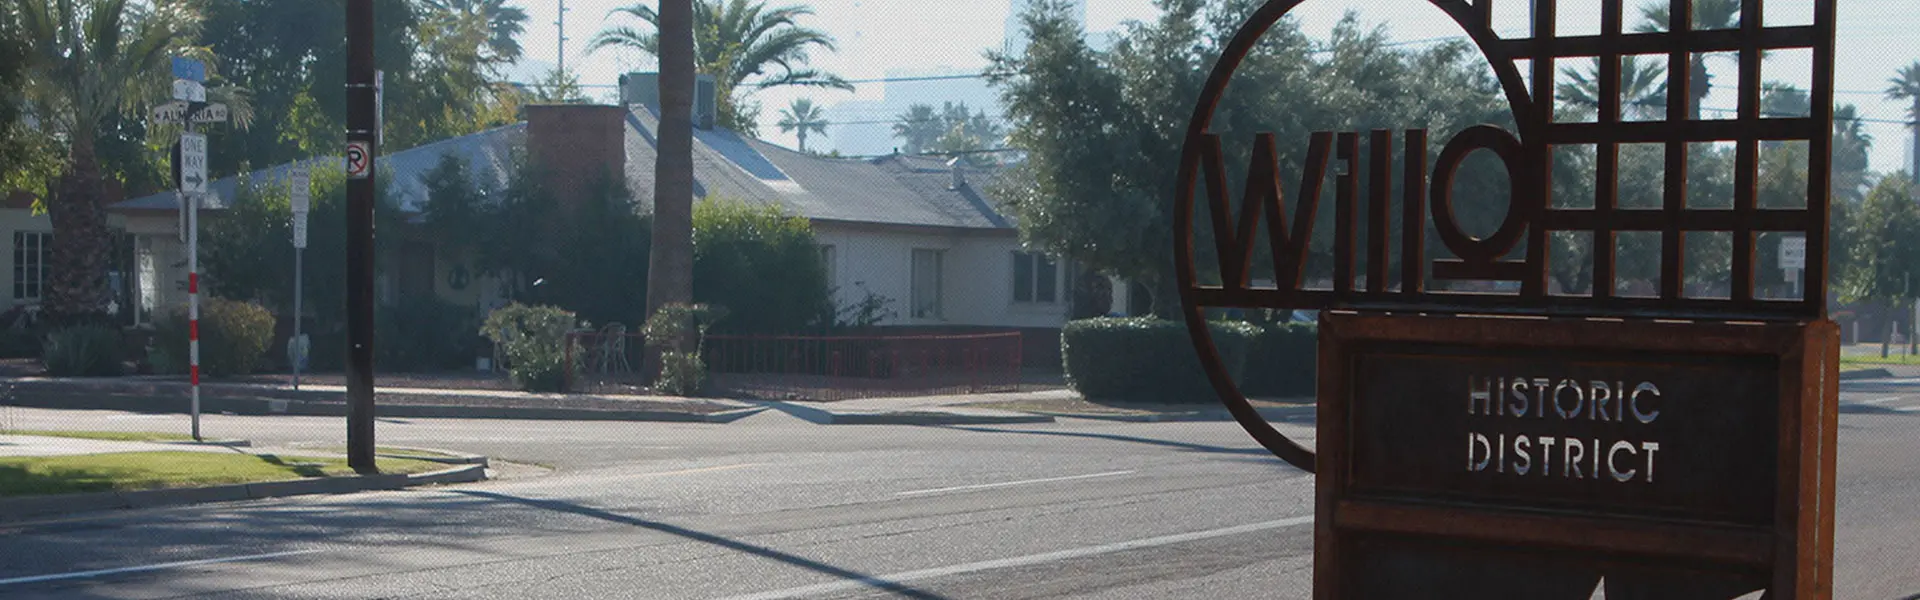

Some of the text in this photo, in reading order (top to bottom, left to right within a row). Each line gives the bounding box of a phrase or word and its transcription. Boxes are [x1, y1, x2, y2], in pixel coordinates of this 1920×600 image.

[163, 108, 213, 121] ALMRIA
[184, 137, 203, 152] ONE
[184, 154, 204, 169] WAY
[1468, 375, 1660, 424] HISTORIC
[1466, 432, 1660, 483] DISTRICT
